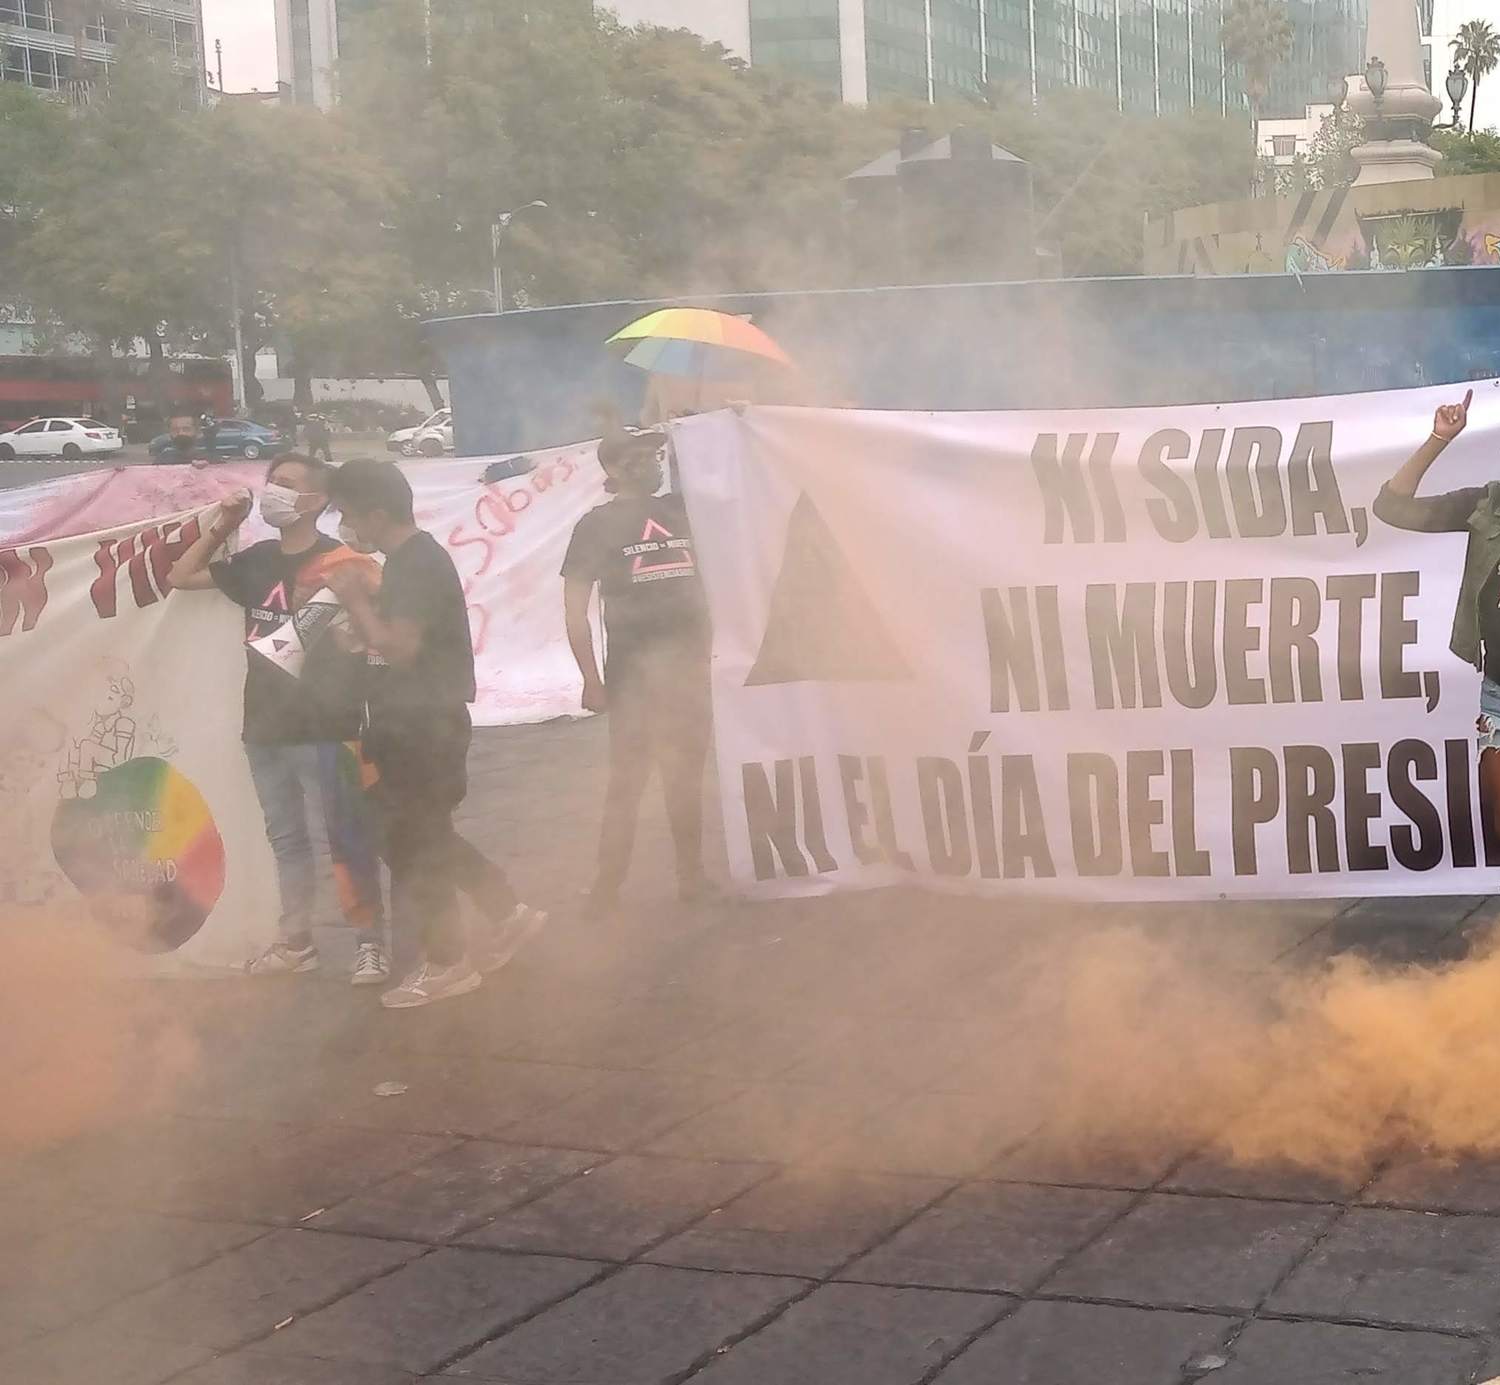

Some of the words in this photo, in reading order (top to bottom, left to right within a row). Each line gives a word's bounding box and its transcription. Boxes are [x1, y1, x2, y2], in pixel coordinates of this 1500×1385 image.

[1031, 431, 1128, 544] NI
[1136, 420, 1369, 548] SIDA,
[980, 584, 1071, 713] NI
[1084, 570, 1441, 714] MUERTE,
[741, 754, 838, 882] NI
[837, 753, 917, 873] EL
[916, 730, 1057, 879] DÍA
[1066, 747, 1212, 877] DEL
